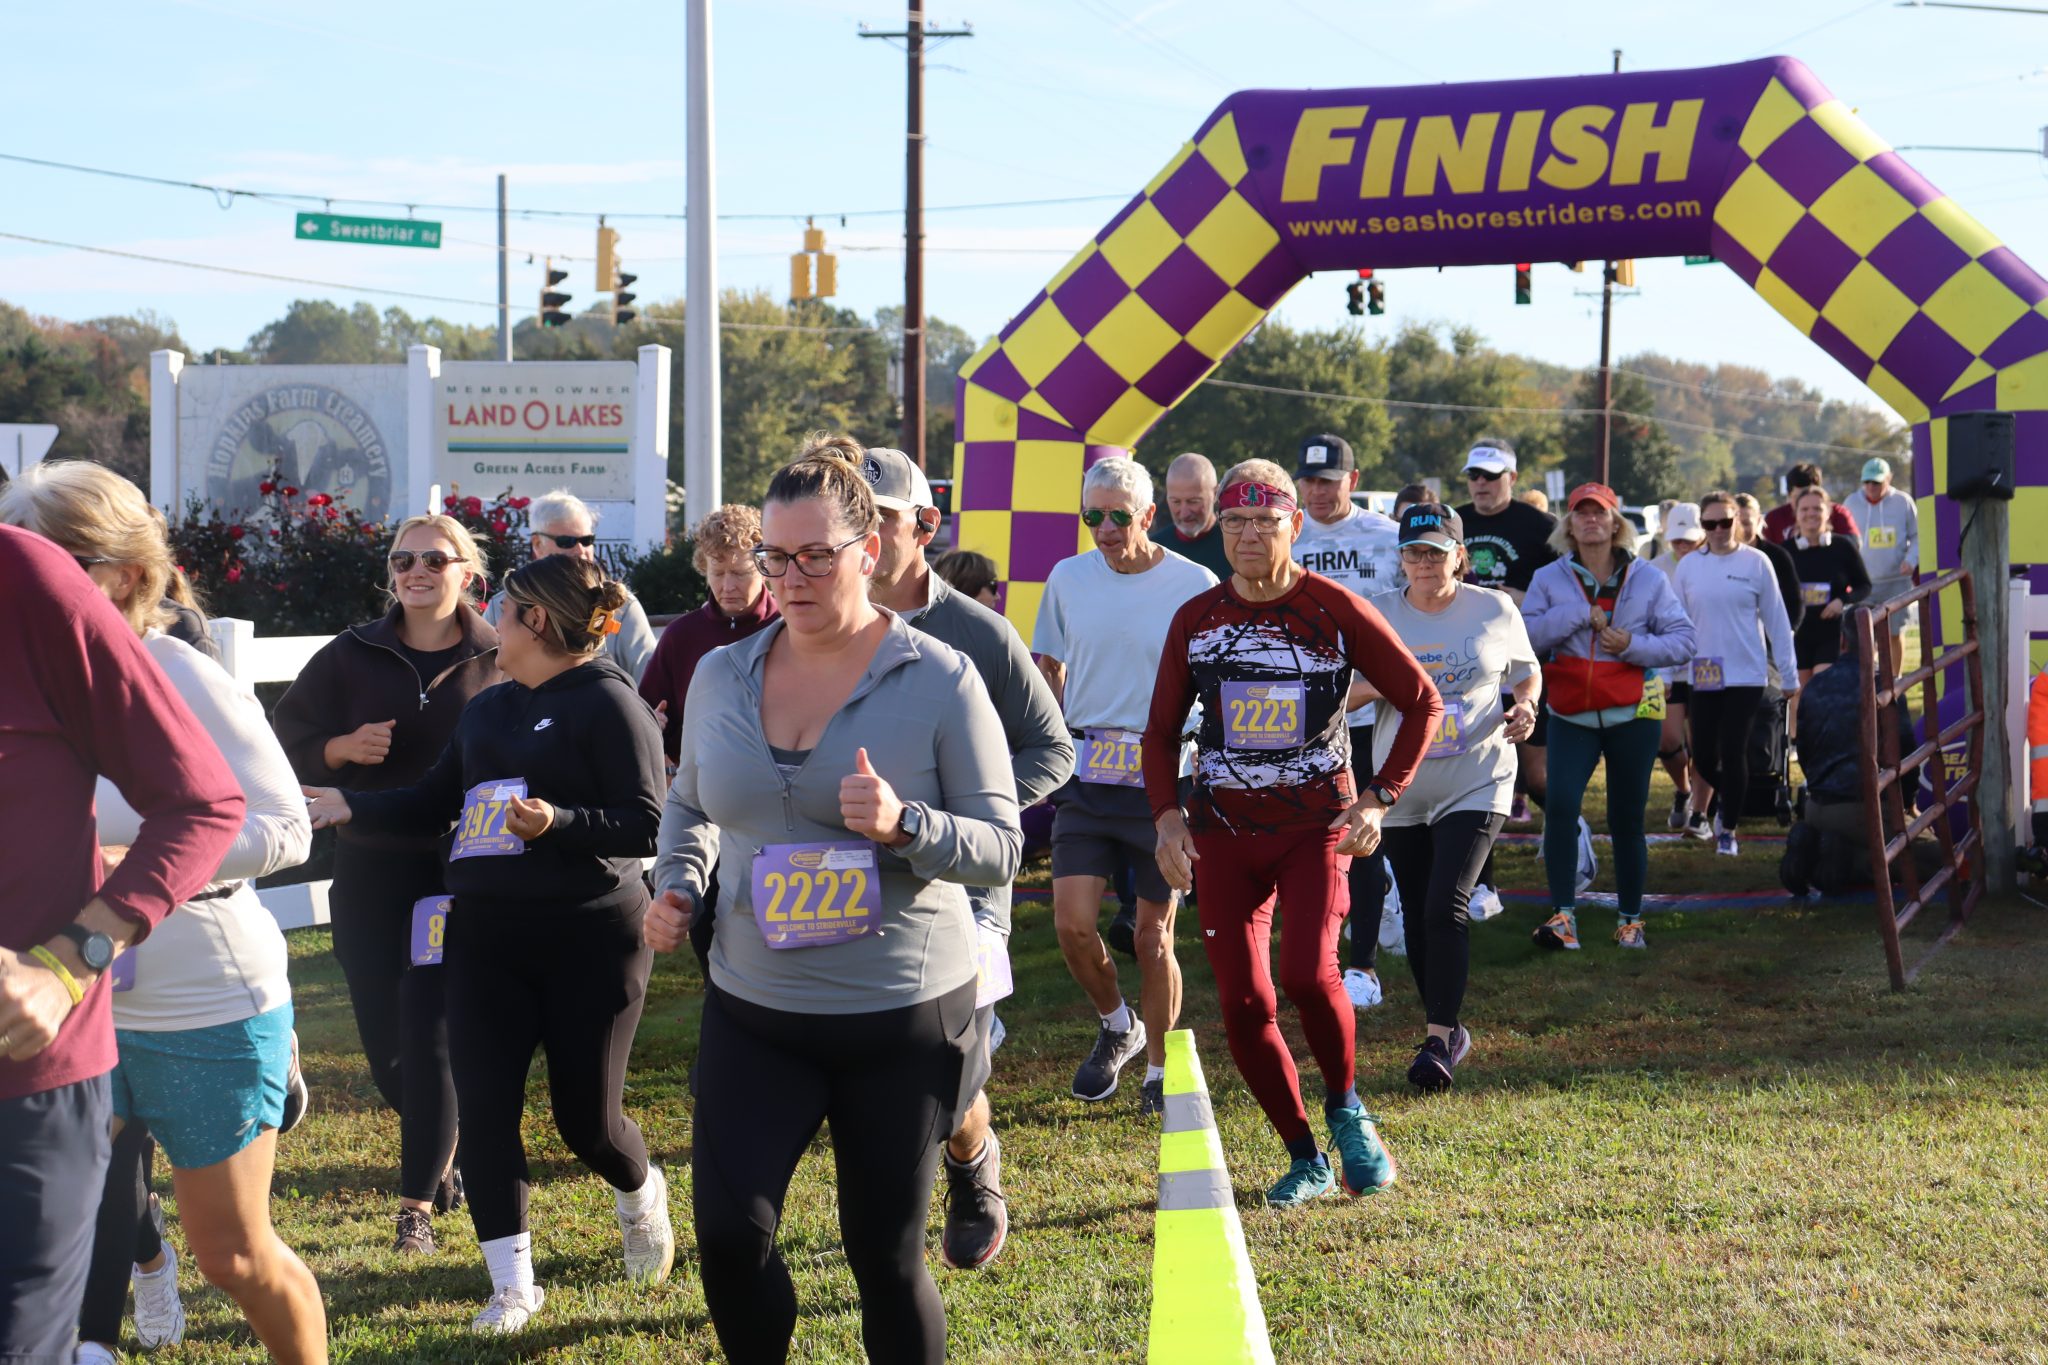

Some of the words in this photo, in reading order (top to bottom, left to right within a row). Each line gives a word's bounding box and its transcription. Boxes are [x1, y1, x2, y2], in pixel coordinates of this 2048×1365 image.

[1280, 98, 1705, 202] FINISH
[330, 220, 415, 242] Sweetbriar
[421, 230, 438, 244] Rd
[1289, 199, 1701, 237] www.seashorestriders.com
[265, 388, 319, 412] Farm
[446, 386, 539, 395] MEMBER
[555, 386, 630, 395] OWNER
[448, 403, 516, 427] LAND
[523, 400, 550, 431] O
[555, 403, 623, 427] LAKES
[1410, 514, 1442, 529] RUN
[1302, 551, 1359, 572] FIRM
[1230, 699, 1298, 732] 2223
[1088, 740, 1143, 772] 2213
[764, 868, 869, 922] 2222
